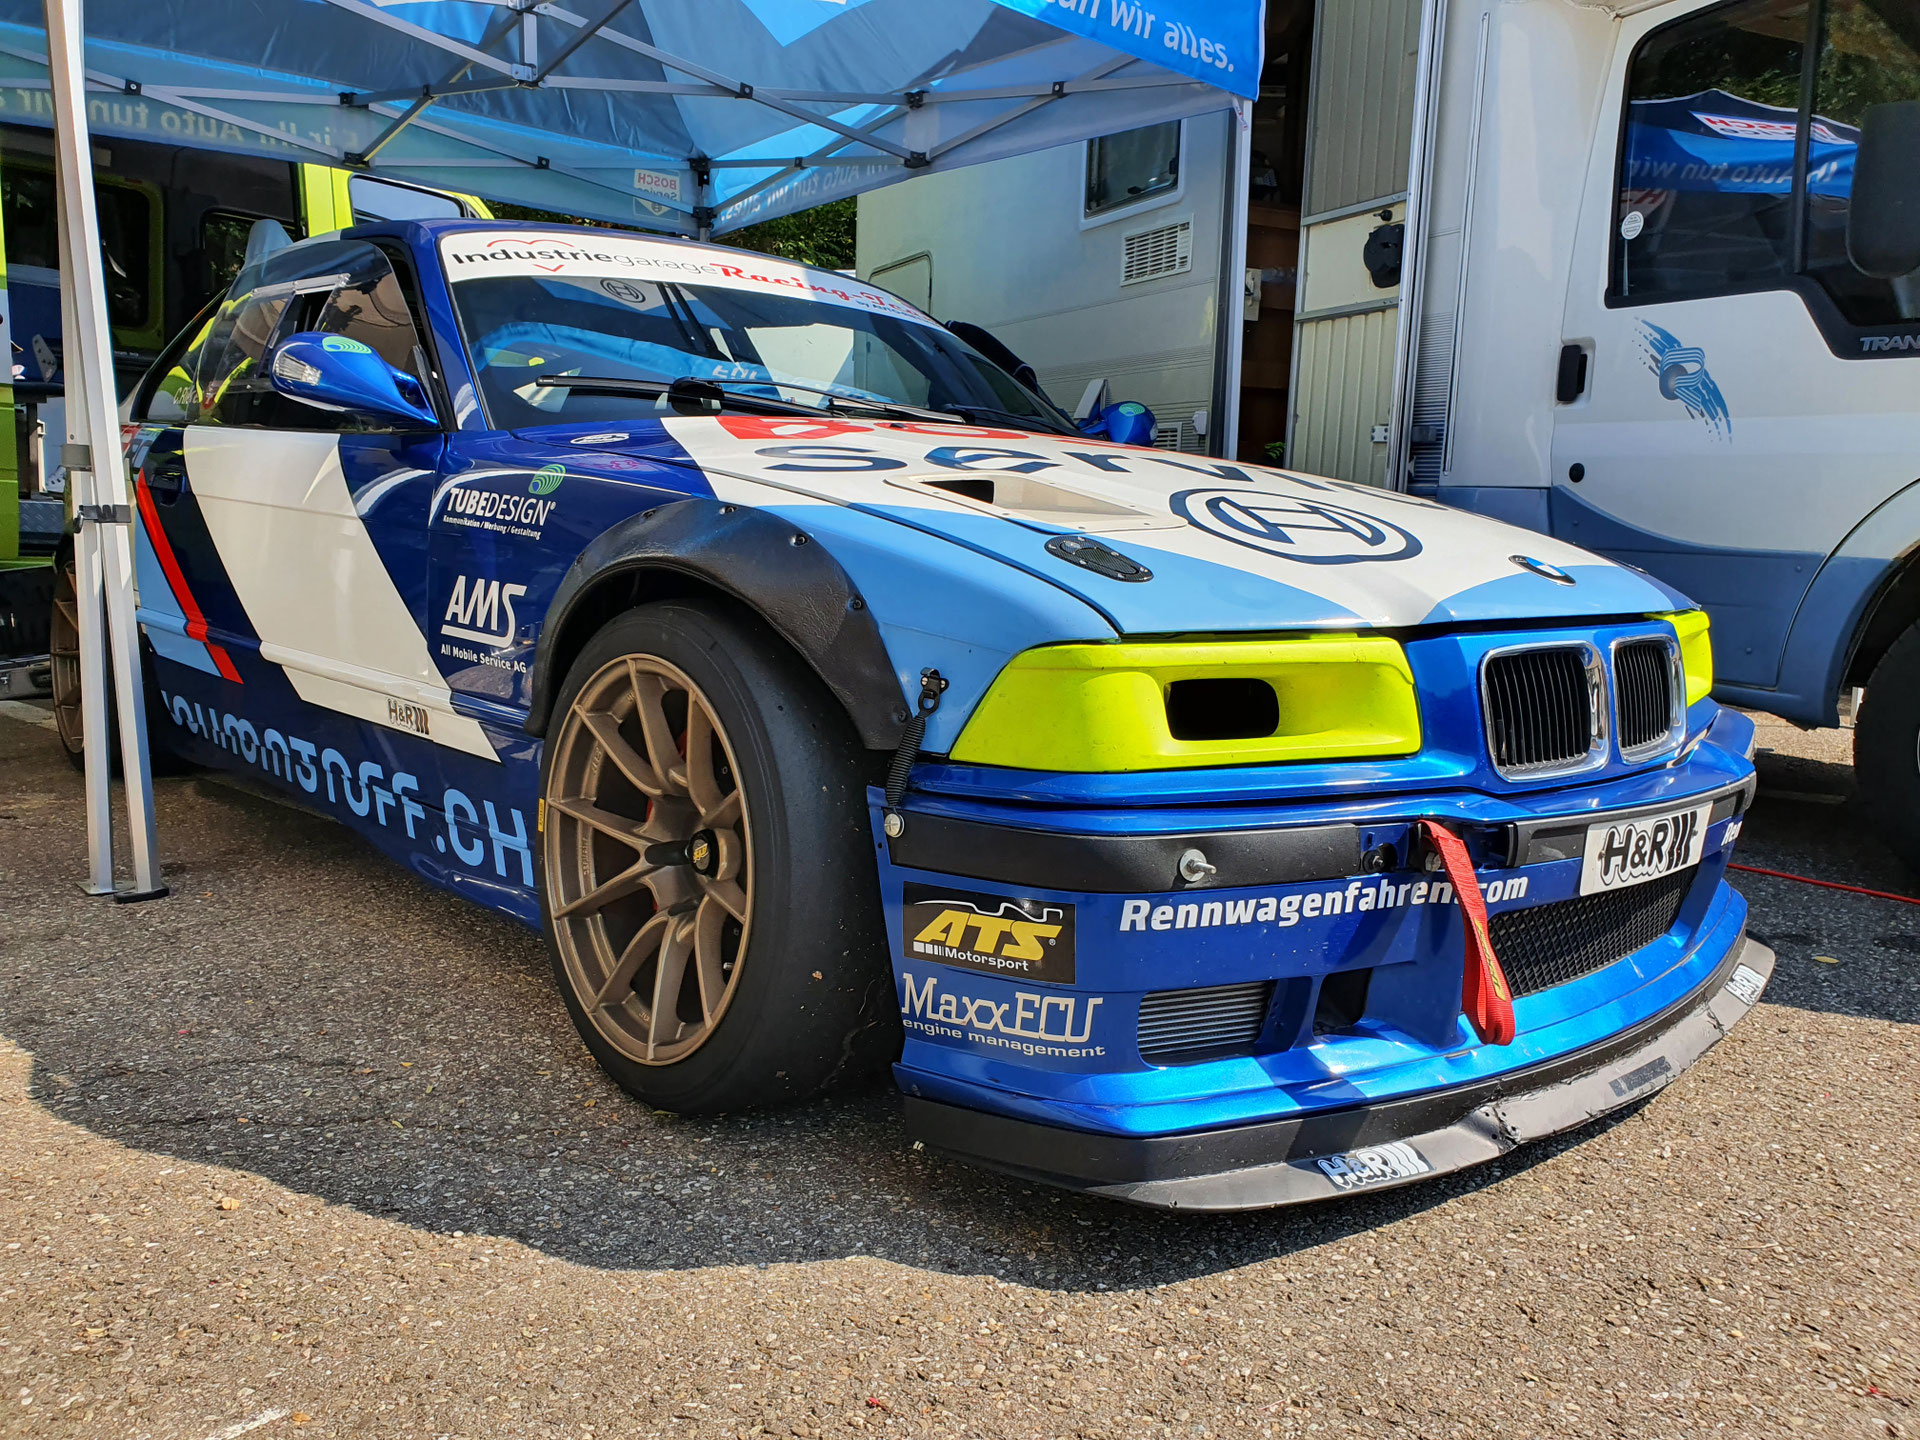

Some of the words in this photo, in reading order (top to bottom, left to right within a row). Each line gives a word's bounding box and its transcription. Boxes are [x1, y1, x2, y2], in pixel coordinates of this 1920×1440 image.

[1110, 0, 1156, 39] wir
[1163, 21, 1235, 73] alles.
[441, 574, 528, 649] AMS
[441, 643, 451, 656] All
[452, 646, 478, 663] Mobile
[479, 653, 511, 670] Service
[513, 660, 527, 674] AG
[944, 946, 1029, 972] Motorsport
[901, 972, 1104, 1044] MaxxECU
[902, 1018, 963, 1040] engine
[968, 1030, 1107, 1058] management
